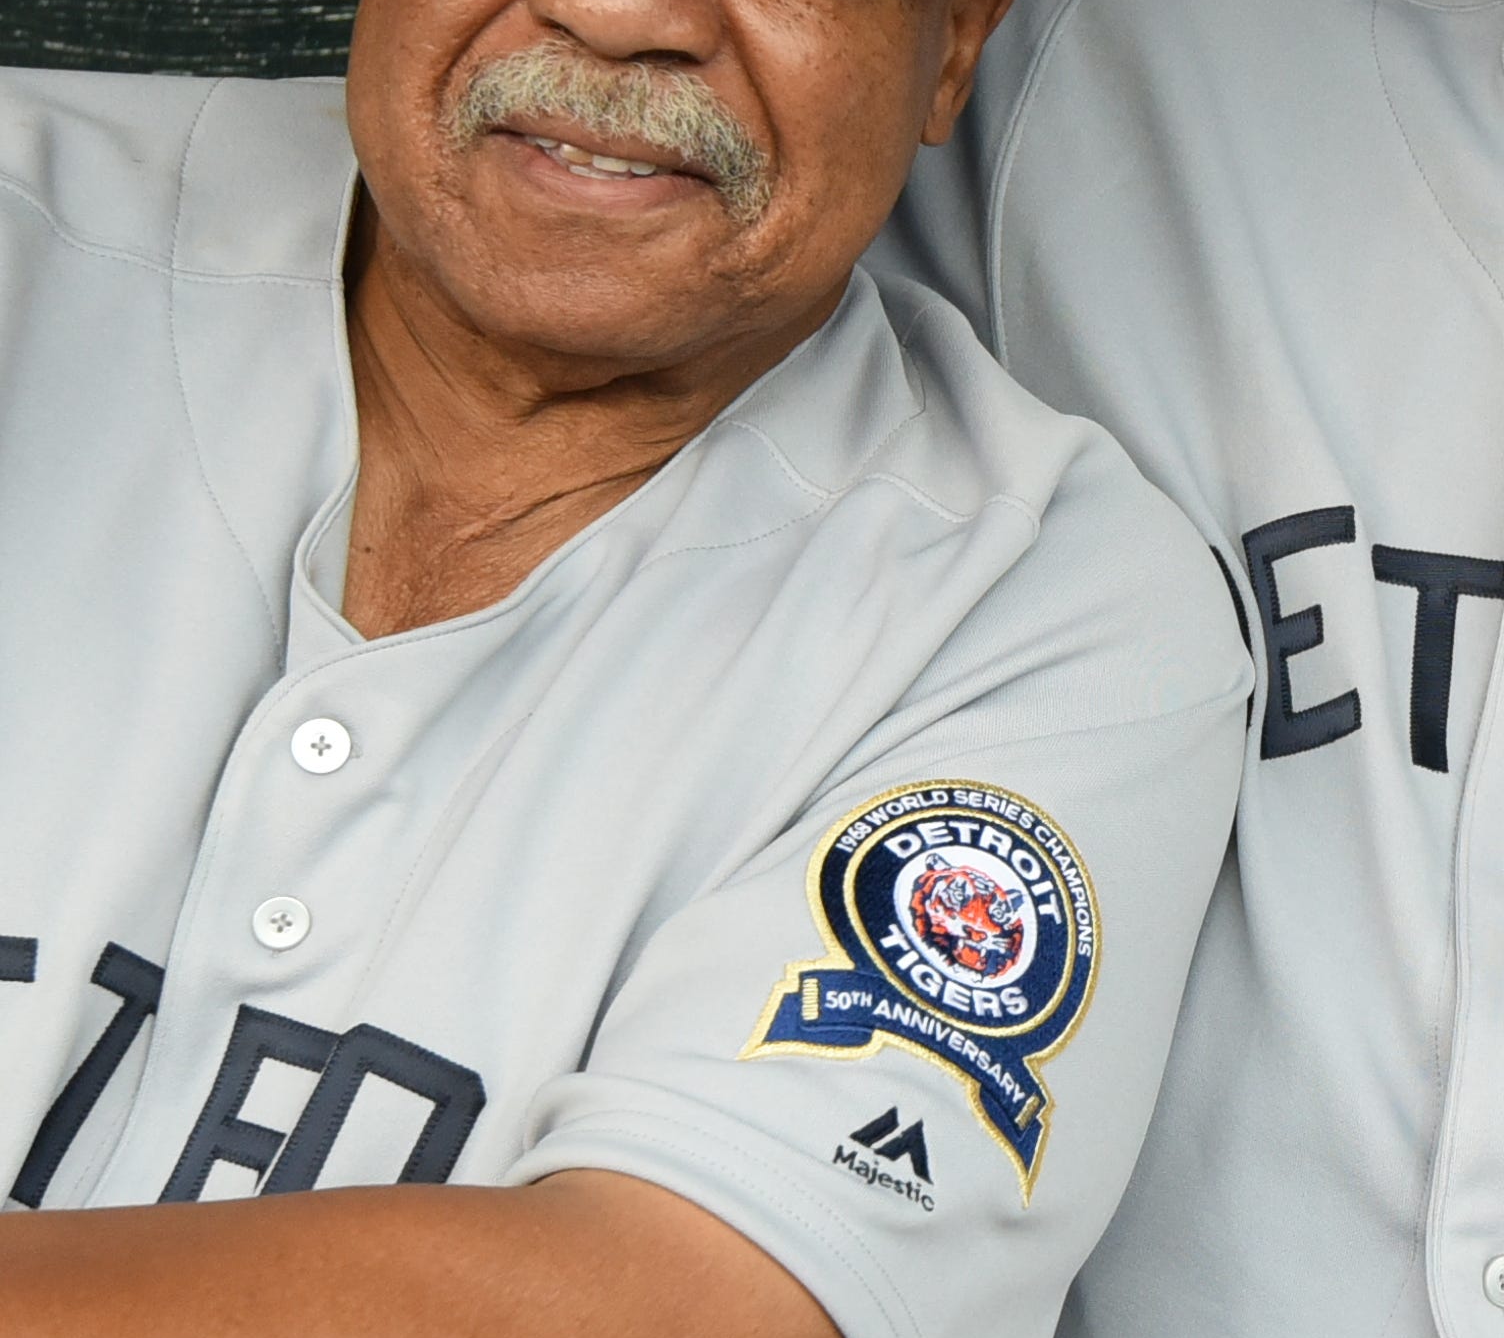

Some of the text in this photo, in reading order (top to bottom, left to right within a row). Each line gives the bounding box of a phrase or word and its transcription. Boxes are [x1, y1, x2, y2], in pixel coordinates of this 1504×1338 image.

[836, 790, 1092, 957] 1968 WORLD SERIES CHAMPIONS
[884, 820, 1062, 925] DETROIT
[879, 924, 1029, 1018] TIGERS
[825, 989, 1026, 1104] 50TH ANNIVERSARY
[832, 1144, 935, 1212] Majestic
